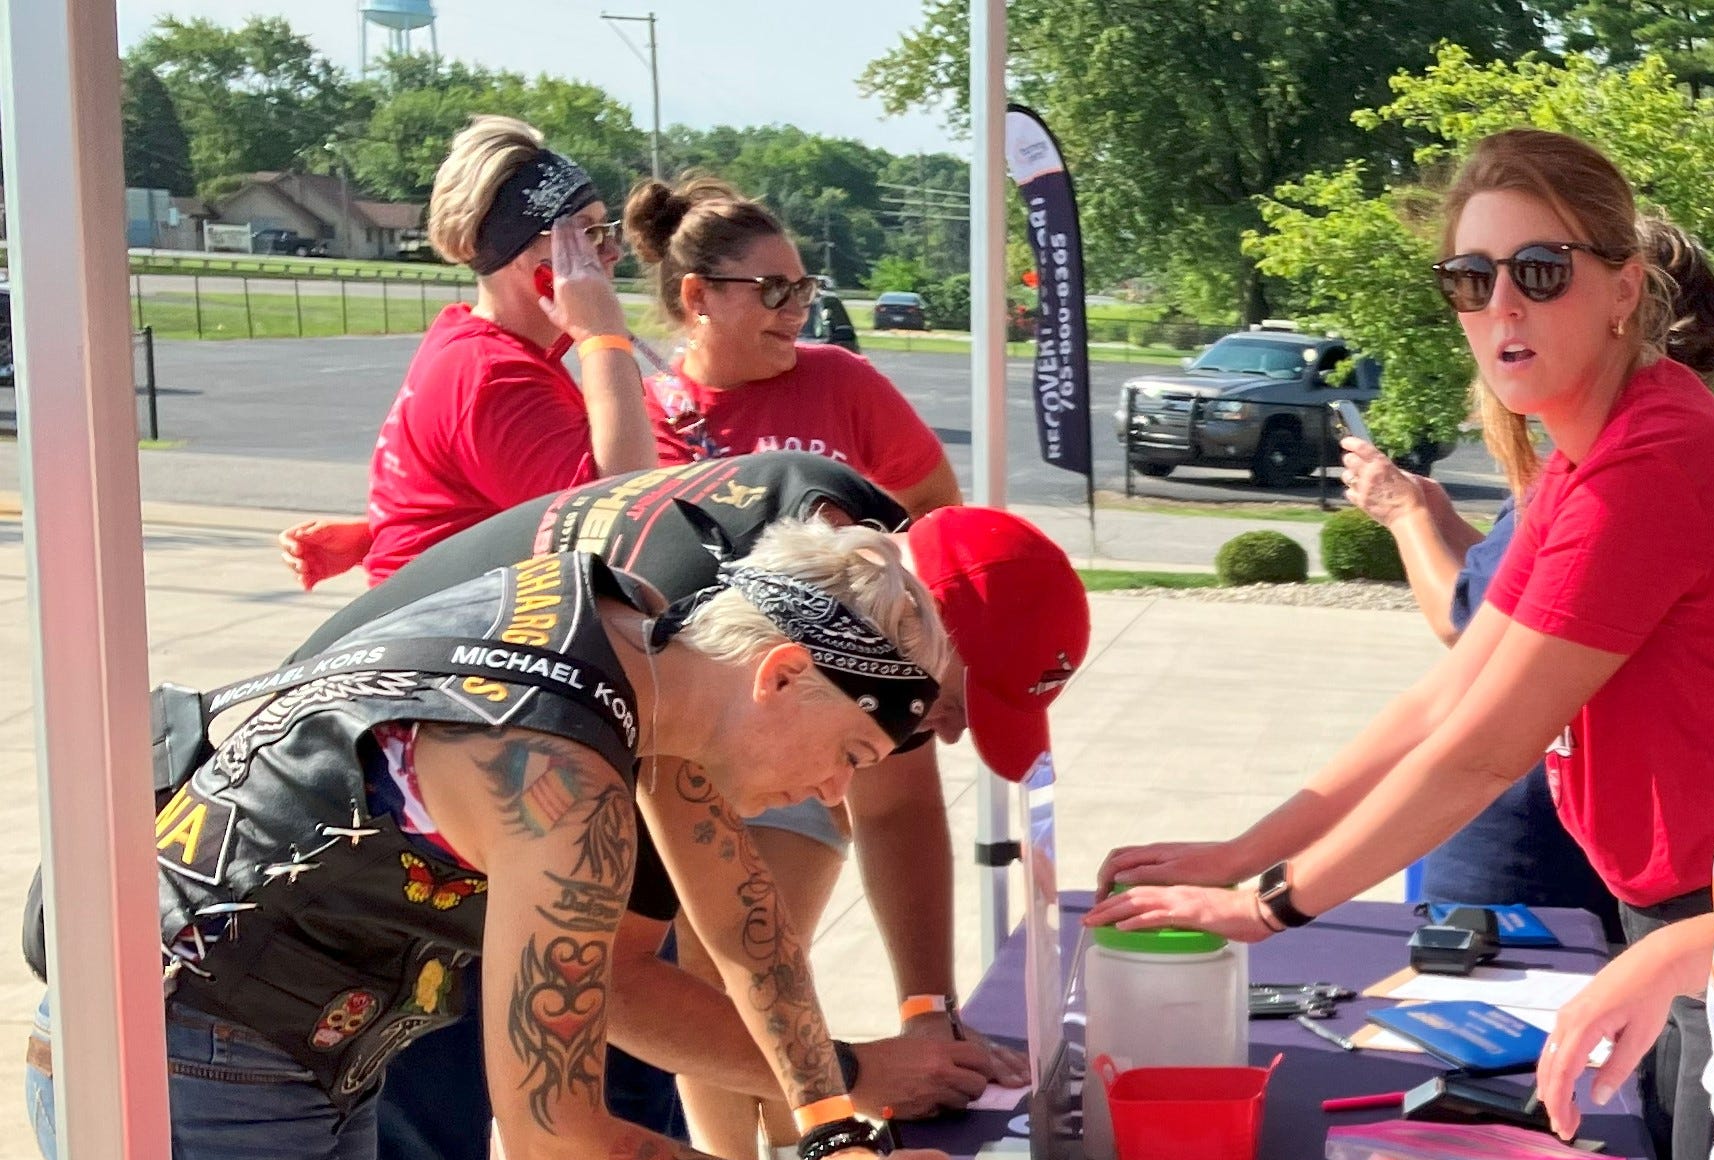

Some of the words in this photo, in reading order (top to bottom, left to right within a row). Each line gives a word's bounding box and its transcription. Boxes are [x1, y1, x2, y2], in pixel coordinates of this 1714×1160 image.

[208, 665, 304, 713] MICHAEL
[315, 645, 386, 676] KORS
[450, 644, 587, 691] MICHAEL
[594, 681, 639, 750] KORS
